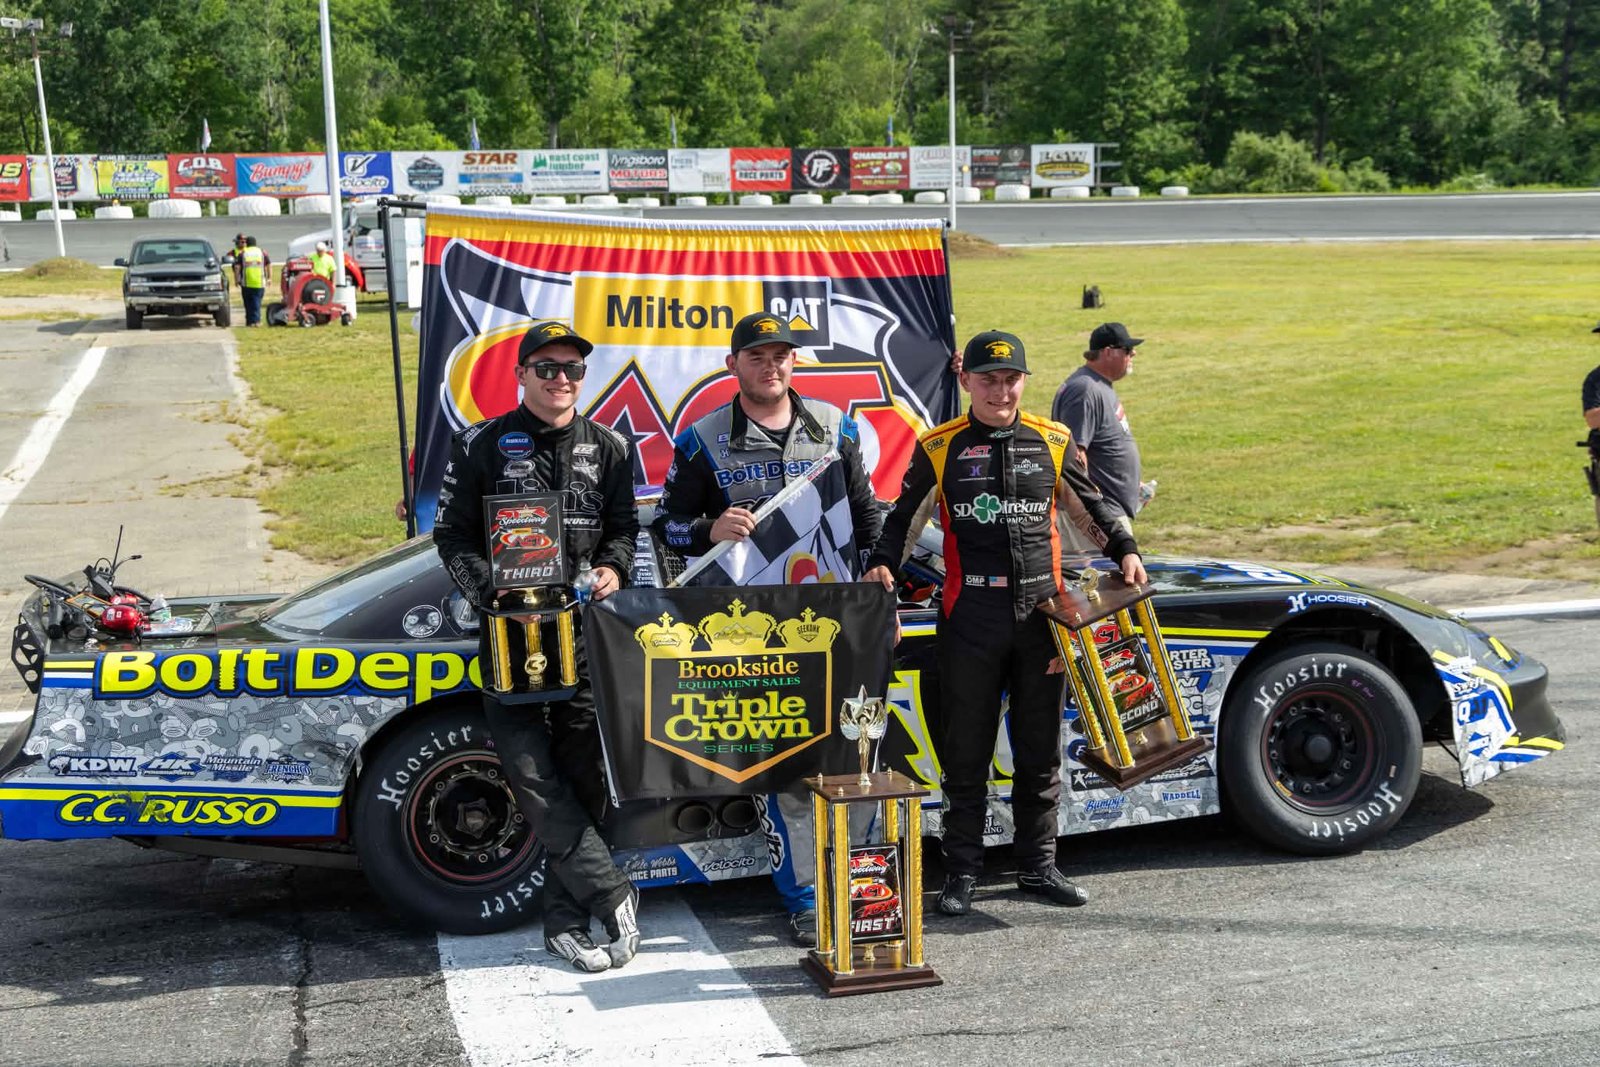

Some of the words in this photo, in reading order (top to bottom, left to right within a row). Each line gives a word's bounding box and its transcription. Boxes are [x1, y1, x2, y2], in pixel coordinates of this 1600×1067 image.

[463, 153, 518, 165] STAR
[606, 294, 733, 330] Milton
[770, 297, 821, 330] CAT
[716, 463, 765, 488] Bolt
[954, 503, 973, 518] SD
[1001, 497, 1051, 515] Ireland
[503, 566, 554, 580] THIRD
[966, 575, 986, 586] OMP
[1308, 594, 1368, 606] HOOSIER
[101, 648, 279, 693] Bolt
[678, 656, 799, 679] Brookside
[678, 679, 760, 690] EQUIPMENT
[762, 677, 801, 686] SALES
[1253, 657, 1349, 718] Hoosier
[671, 690, 807, 720] Triple
[1120, 701, 1159, 724] ECOND
[664, 715, 814, 742] Crown
[704, 743, 774, 754] SERIES
[70, 758, 134, 771] KDW
[207, 756, 263, 765] Mountain
[377, 724, 473, 811] Hoosier
[1161, 790, 1201, 802] WADDELL
[60, 797, 127, 822] C.C.
[140, 797, 277, 824] RUSSO
[1309, 783, 1403, 842] Hoosier
[650, 867, 678, 879] PARTS
